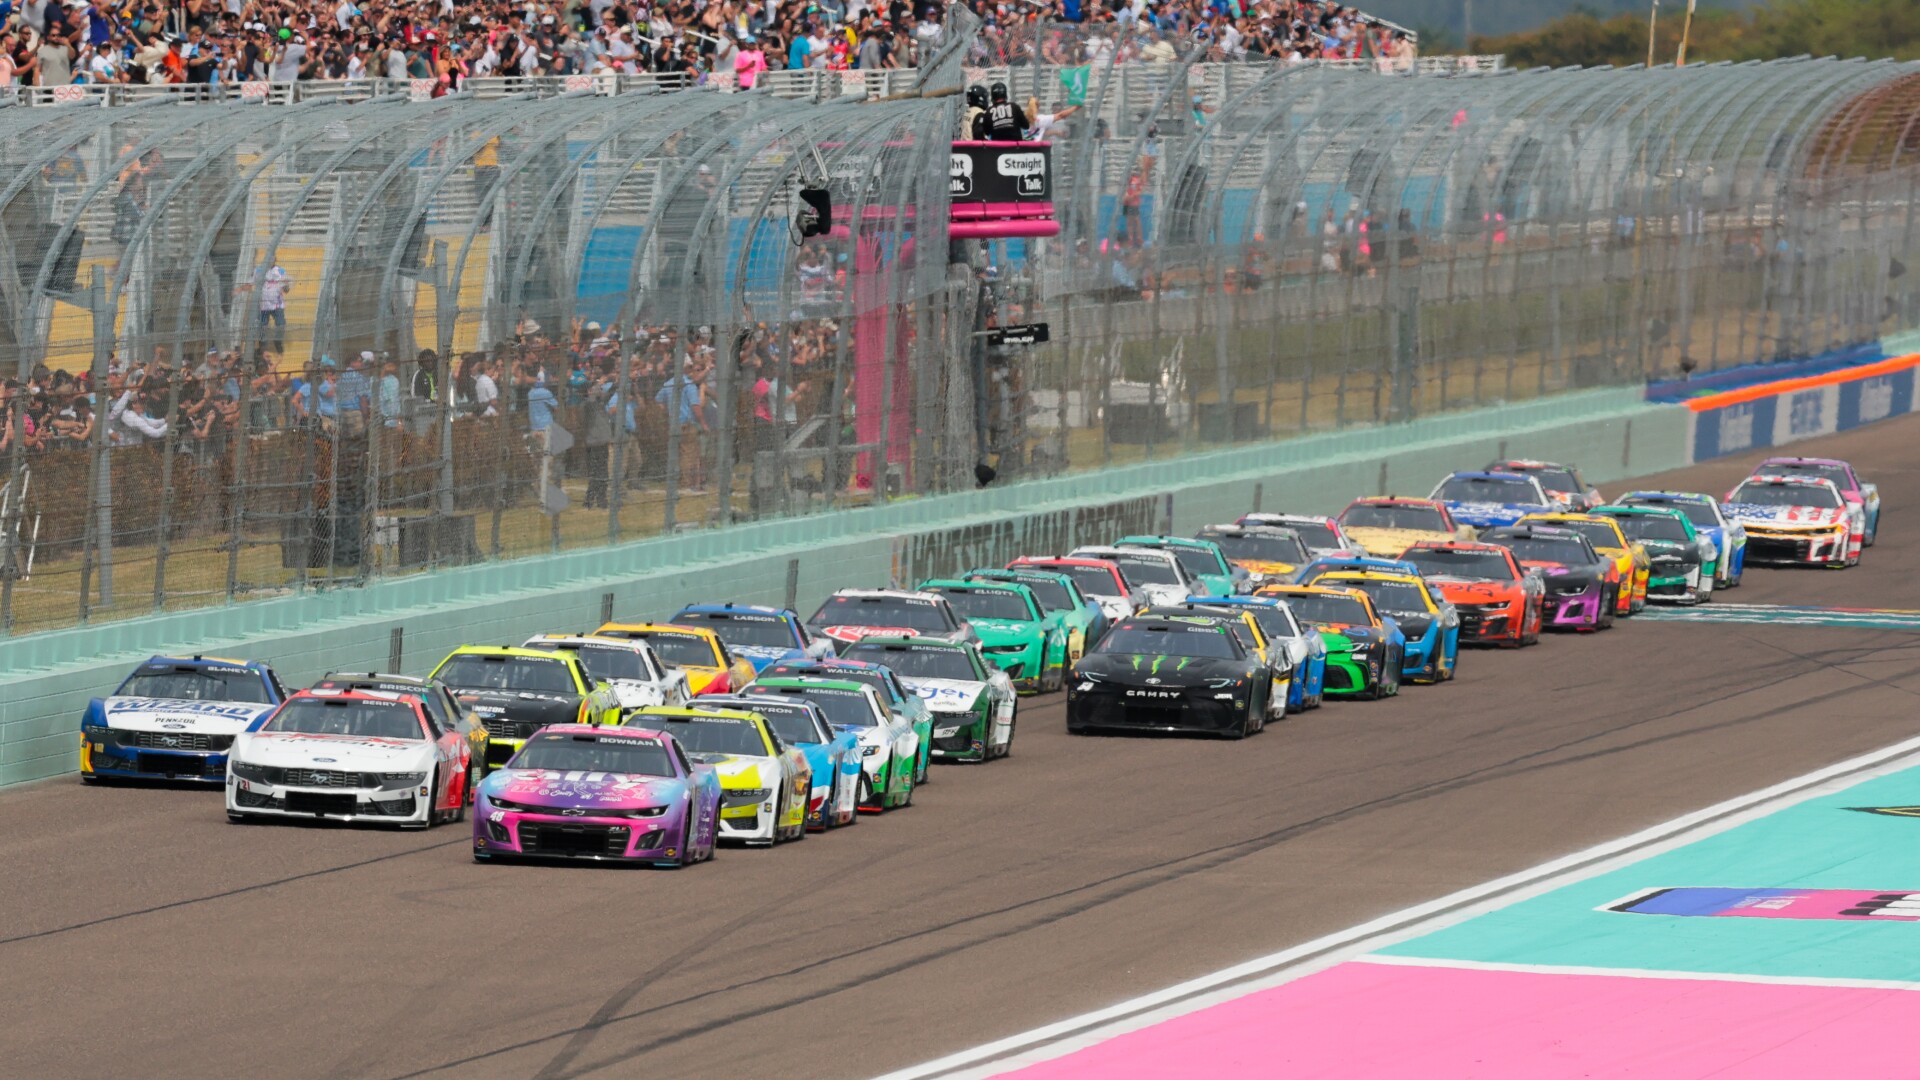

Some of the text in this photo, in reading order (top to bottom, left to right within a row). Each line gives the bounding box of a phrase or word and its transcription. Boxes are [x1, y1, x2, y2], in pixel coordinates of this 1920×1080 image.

[990, 104, 1012, 121] 201
[1004, 158, 1042, 175] Straight
[1024, 179, 1042, 191] Talk
[974, 589, 1014, 597] ELLIOTT
[733, 615, 776, 623] LARSON
[1187, 626, 1219, 634] GIBBS
[657, 632, 698, 640] LOGANO
[207, 666, 248, 674] BLANEY
[826, 668, 876, 677] WALLACE
[379, 683, 429, 693] BRISCOE
[1126, 690, 1180, 698] CAMRY
[112, 701, 252, 716] WIZARD
[752, 706, 793, 714] BYRON
[598, 737, 654, 746] BOWMAN
[490, 811, 505, 822] 48
